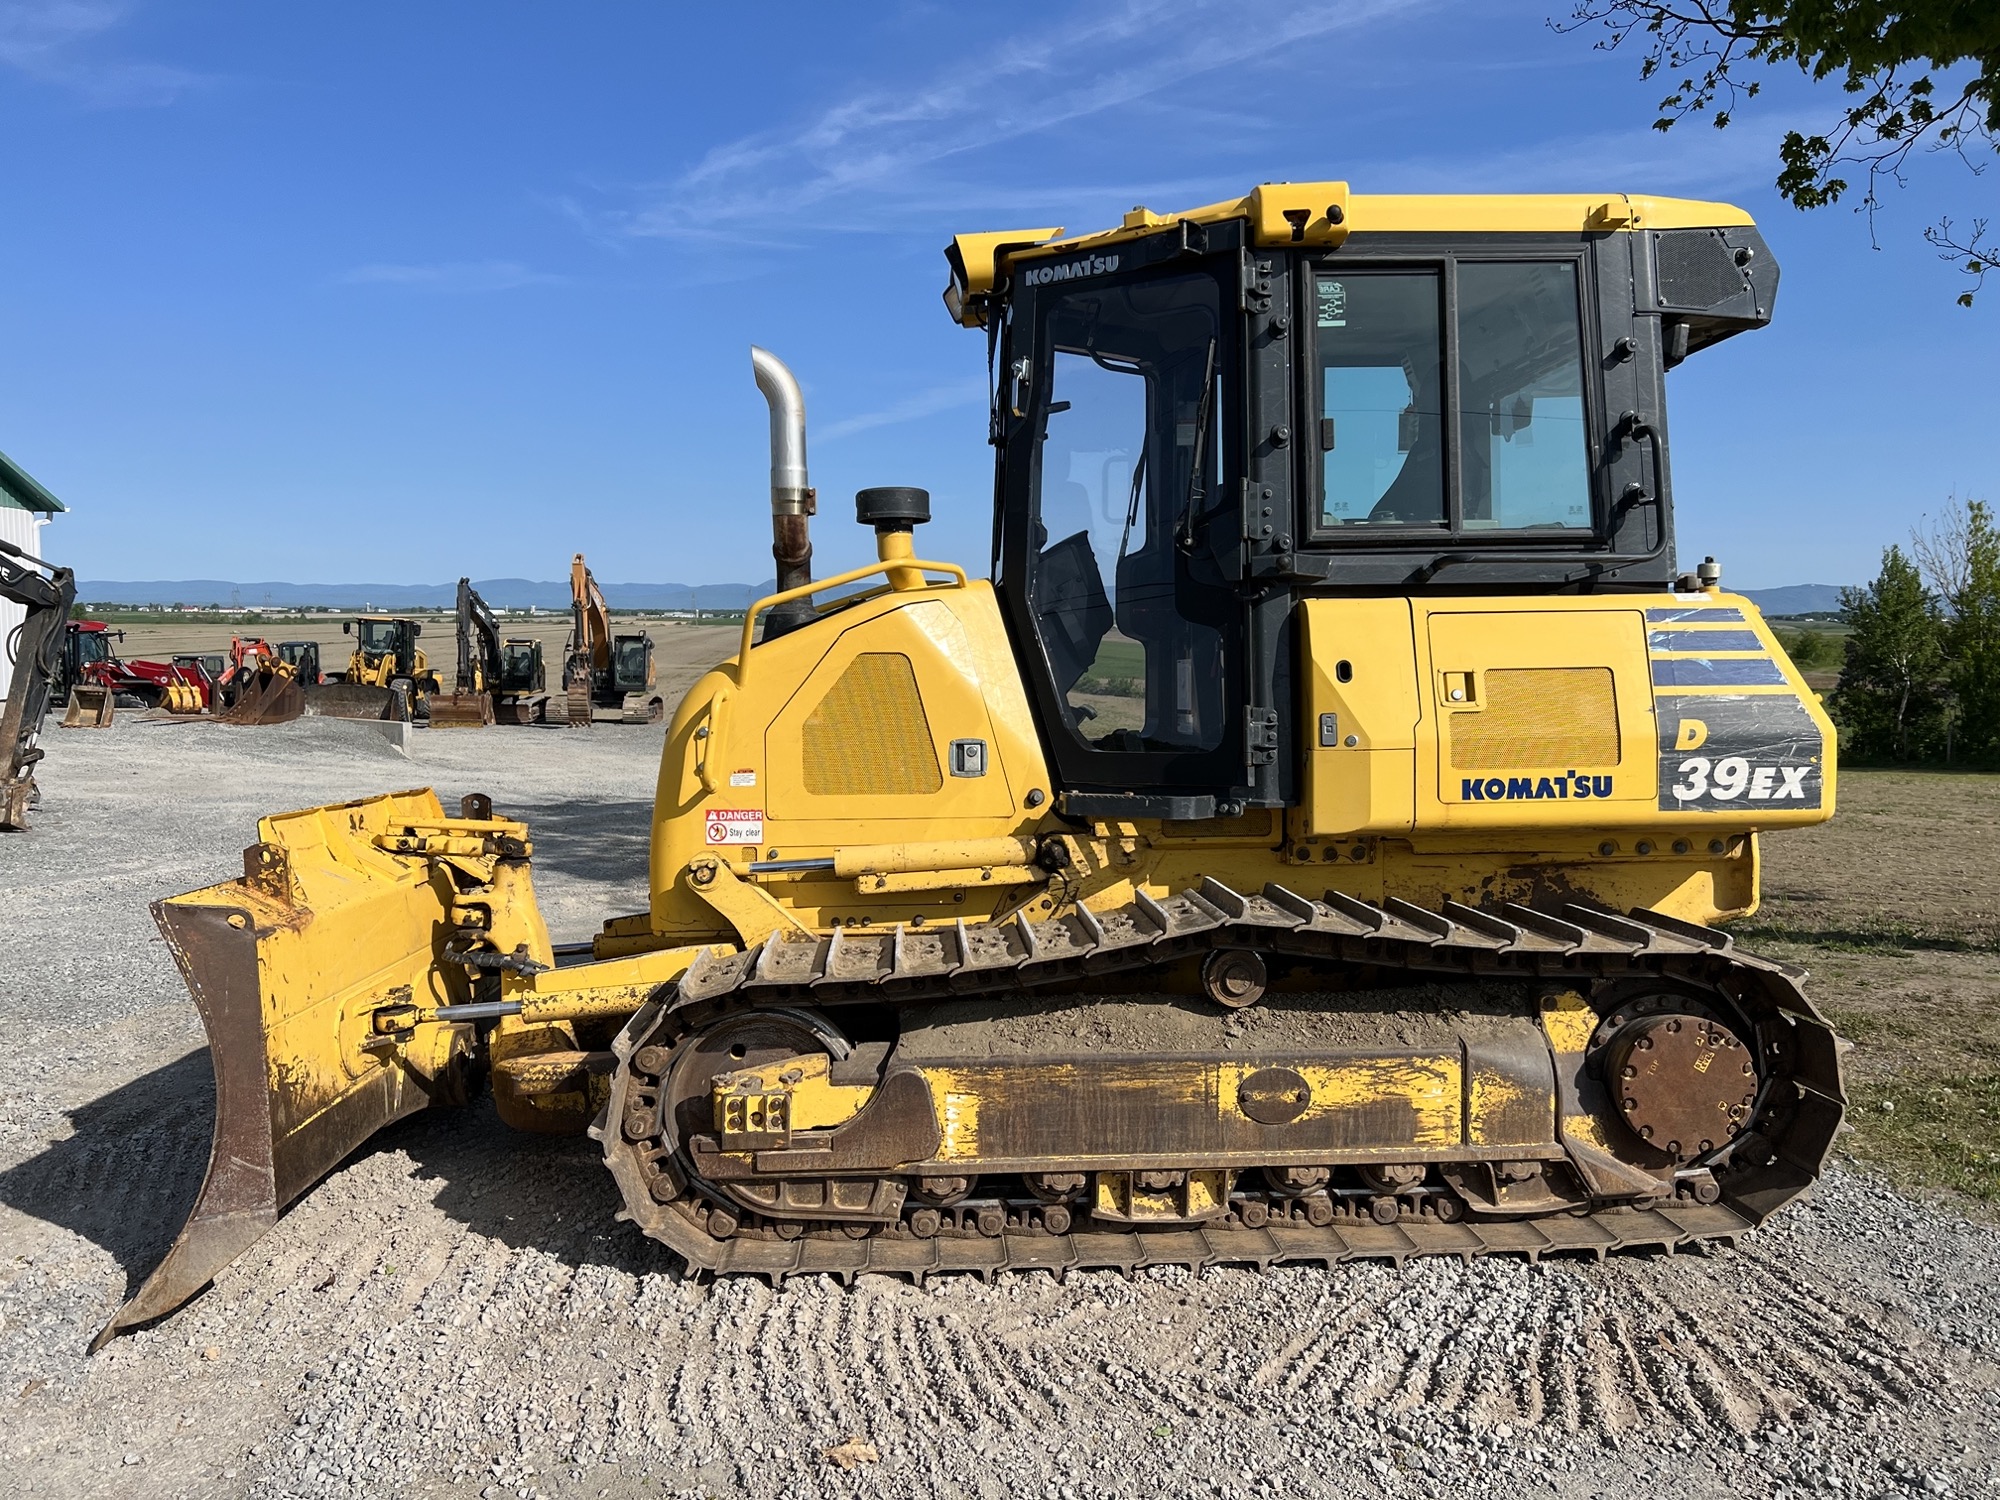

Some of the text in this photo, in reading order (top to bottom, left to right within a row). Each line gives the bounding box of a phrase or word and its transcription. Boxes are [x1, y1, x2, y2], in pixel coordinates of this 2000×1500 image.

[1025, 254, 1119, 286] KOMATSU
[1675, 718, 1708, 750] D
[1461, 769, 1613, 801] KOMATSU
[1672, 756, 1812, 801] 39EX
[719, 811, 762, 819] DANGER
[729, 828, 760, 837] Stay clear
[1647, 1059, 1659, 1076] TOP
